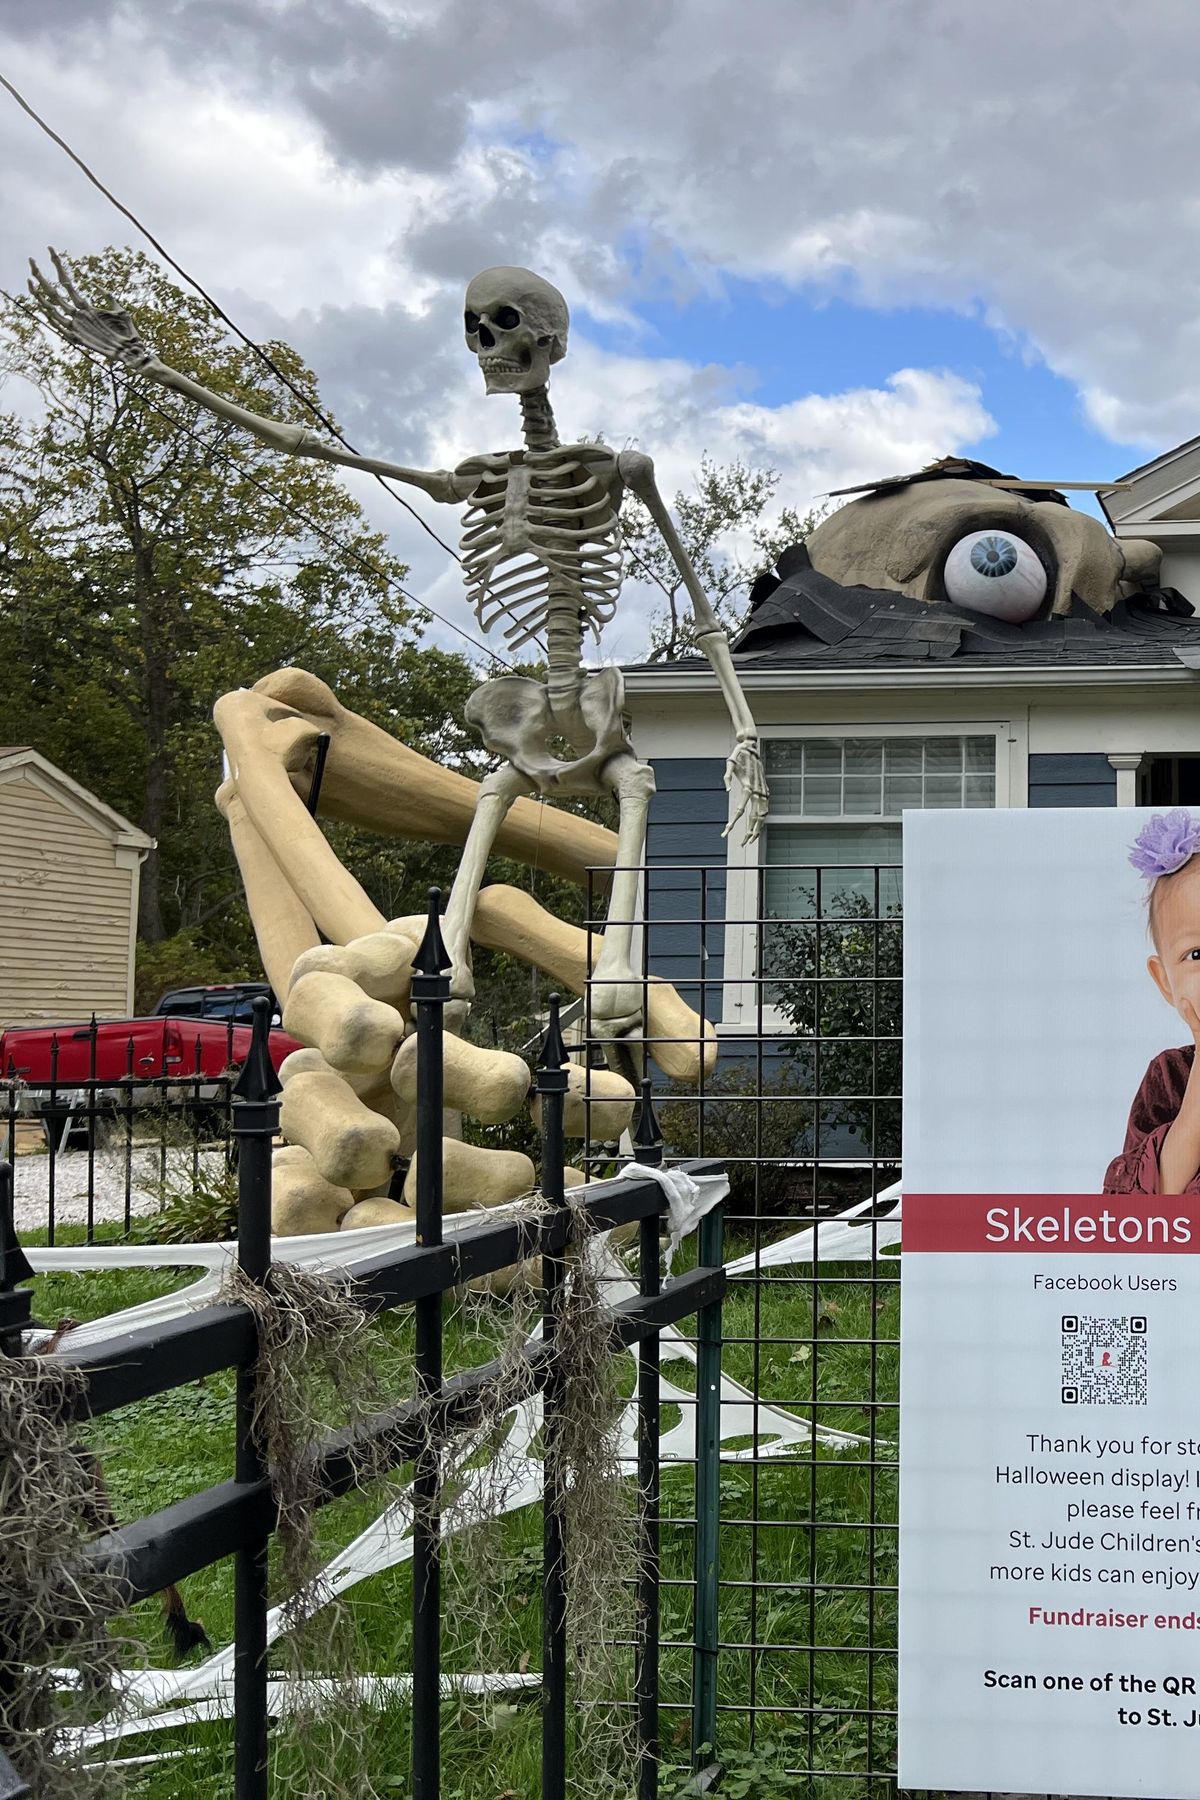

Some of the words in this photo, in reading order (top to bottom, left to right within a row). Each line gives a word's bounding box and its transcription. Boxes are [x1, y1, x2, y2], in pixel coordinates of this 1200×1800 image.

[985, 1207, 1192, 1244] Skeletons
[1034, 1274, 1123, 1291] Facebook
[1128, 1274, 1177, 1292] Users
[1025, 1433, 1092, 1454] Thank
[1096, 1439, 1134, 1459] you
[1140, 1435, 1172, 1455] for
[996, 1465, 1104, 1486] Halloween
[1111, 1467, 1189, 1493] display!
[1067, 1499, 1135, 1523] please
[1140, 1500, 1180, 1520] feel
[1009, 1530, 1036, 1549] St.
[1041, 1531, 1094, 1550] Jude
[990, 1565, 1045, 1581] more
[1051, 1562, 1092, 1583] kids
[1097, 1568, 1135, 1584] can
[1141, 1566, 1200, 1591] enjoy
[1029, 1606, 1149, 1629] Fundraiser
[983, 1669, 1037, 1689] Scan
[1042, 1675, 1084, 1691] one
[1089, 1672, 1114, 1692] of
[1118, 1674, 1157, 1694] the
[1162, 1676, 1197, 1697] QR
[1117, 1707, 1142, 1726] to
[1147, 1708, 1178, 1727] St.
